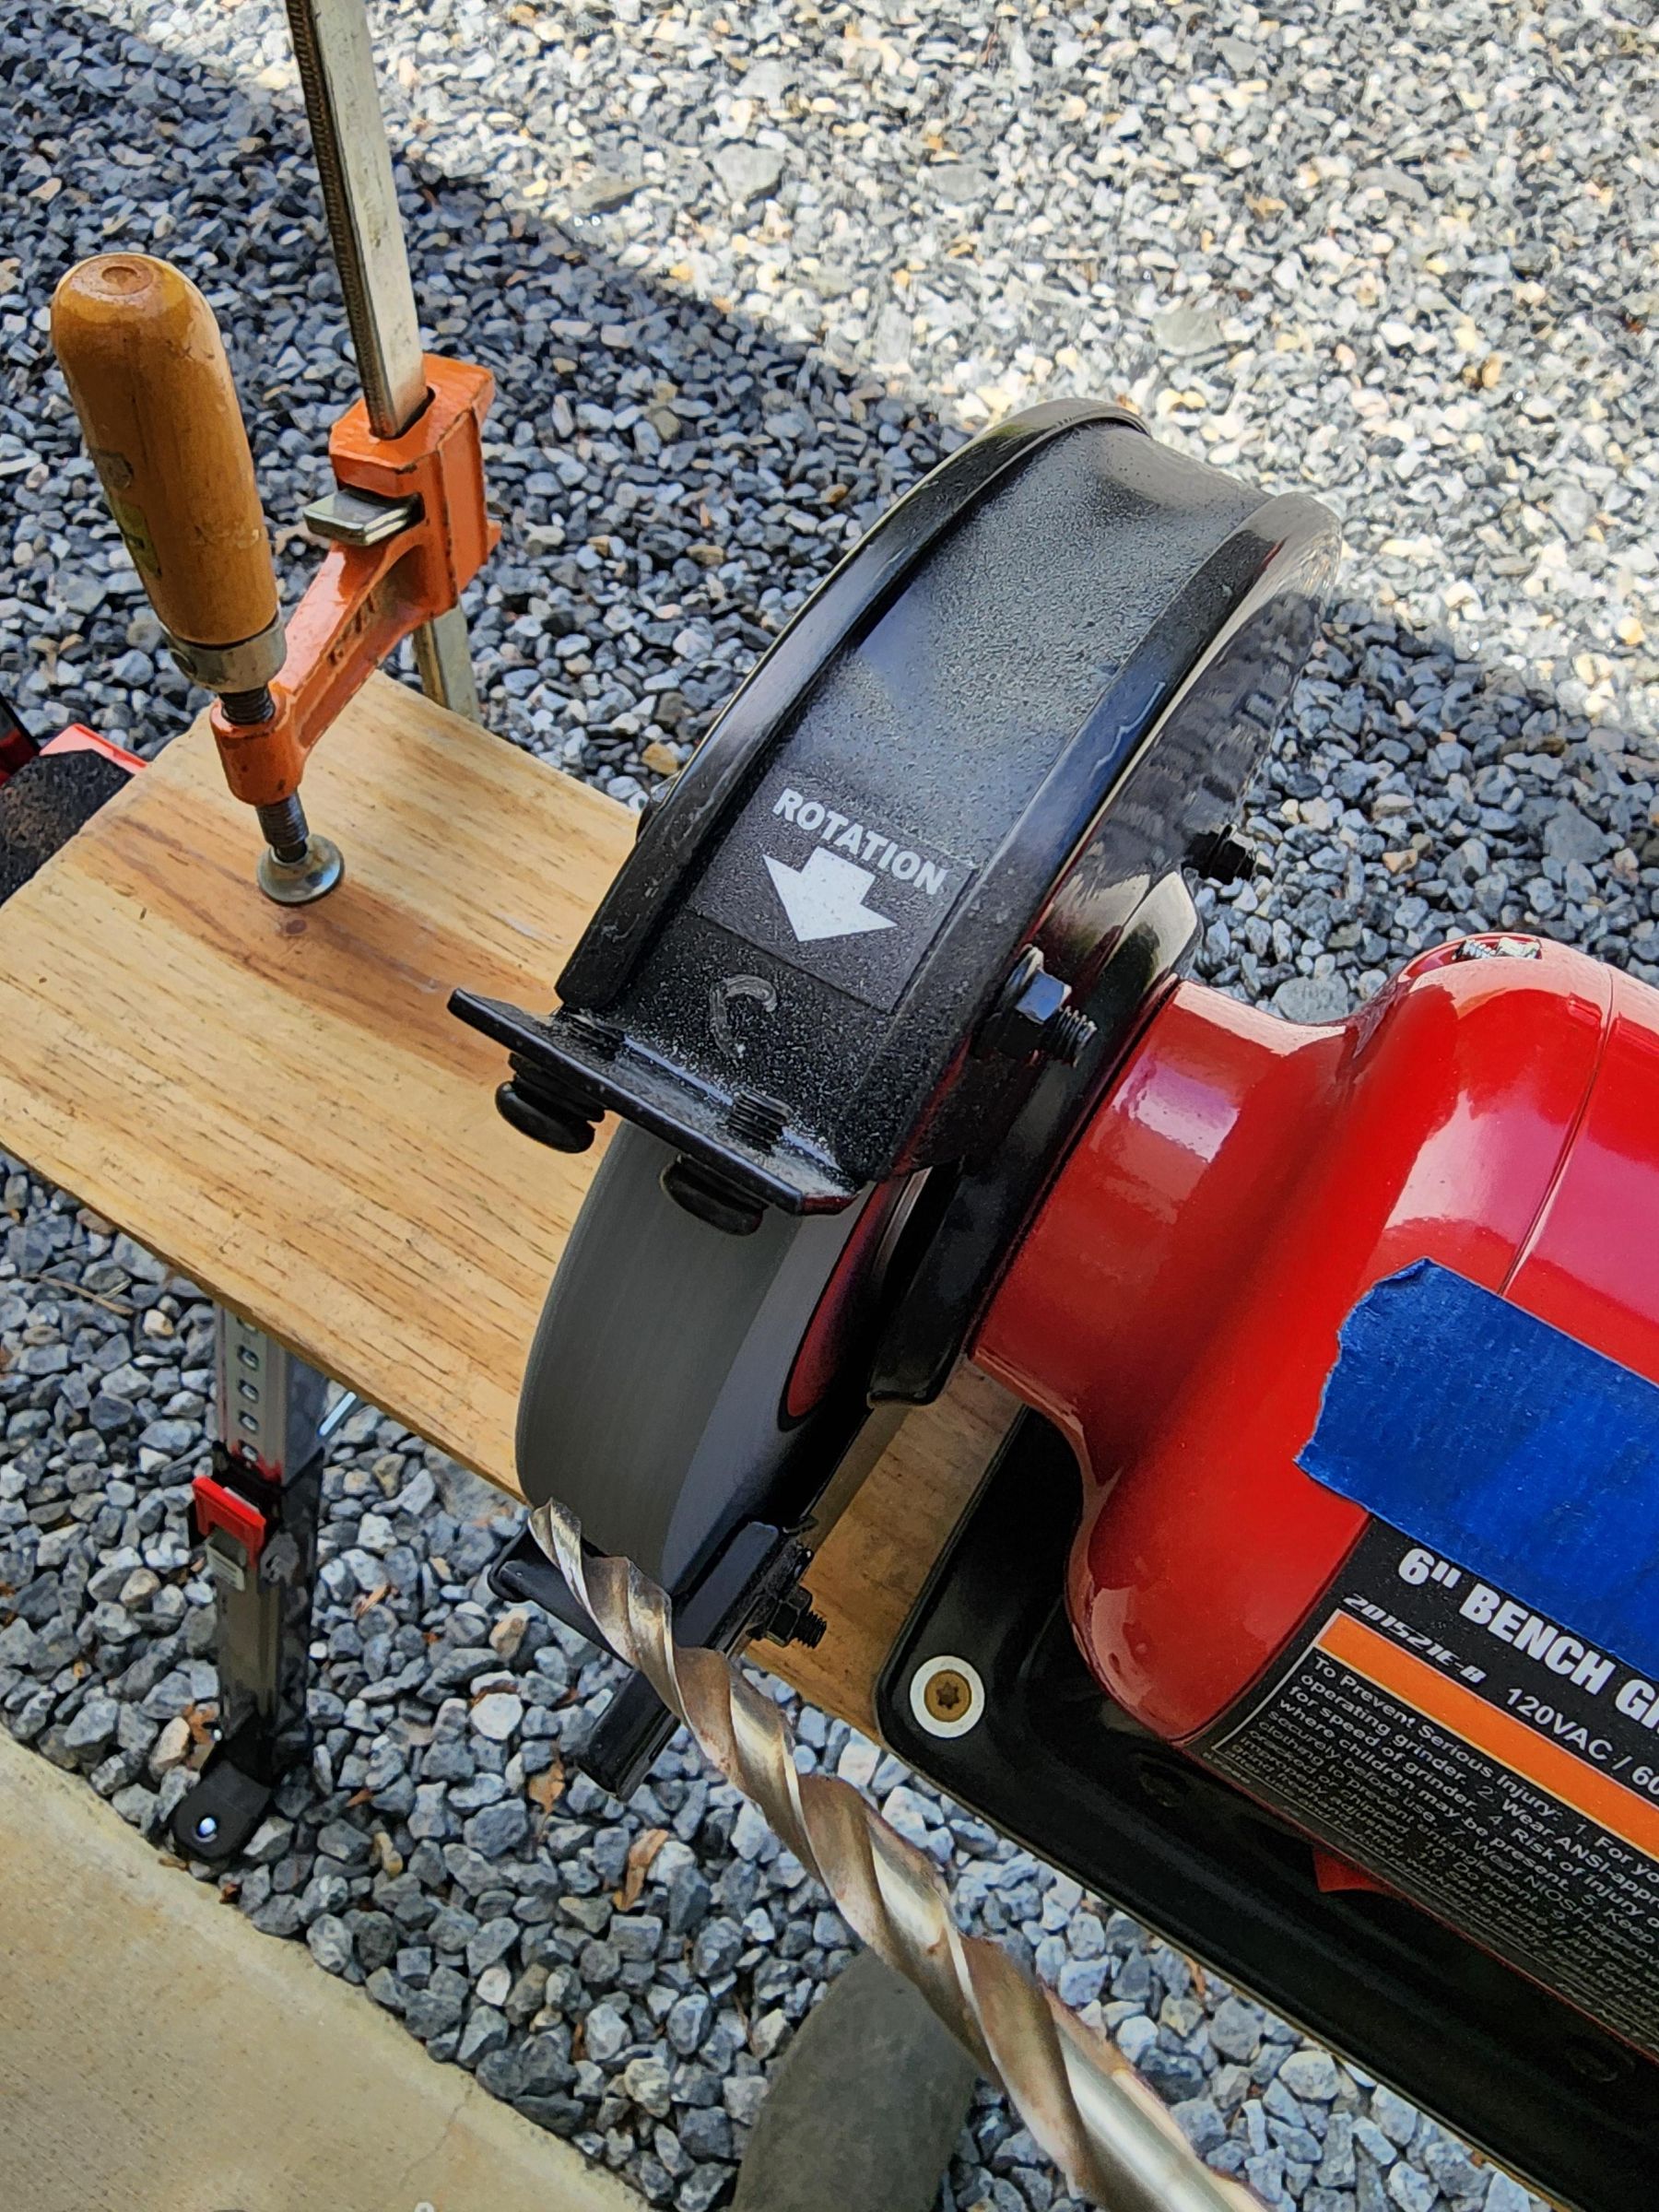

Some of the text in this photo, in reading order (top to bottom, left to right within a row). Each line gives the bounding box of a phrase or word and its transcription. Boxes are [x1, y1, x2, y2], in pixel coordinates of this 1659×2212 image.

[772, 788, 949, 895] ROTATION
[1459, 1583, 1617, 1695] BENCH
[1507, 1688, 1613, 1760] 120VAC
[1612, 1755, 1633, 1771] /
[1248, 1730, 1317, 1774] cracked
[1318, 1775, 1339, 1787] or
[1452, 1861, 1479, 1881] Do
[1482, 1881, 1514, 1903] not
[1514, 1902, 1548, 1925] use
[1258, 1721, 1324, 1767] clothing
[1327, 1764, 1346, 1779] to
[1347, 1776, 1415, 1823] prevent
[1573, 1924, 1642, 1971] Inspect
[1267, 1711, 1342, 1759] securely
[1343, 1757, 1399, 1798] before
[1402, 1796, 1438, 1827] use.
[1474, 1840, 1523, 1875] Wear
[1524, 1875, 1659, 1969] NIOSH-approv
[1279, 1699, 1335, 1738] where
[1338, 1738, 1416, 1790] children
[1418, 1790, 1461, 1818] may
[1461, 1817, 1488, 1837] be
[1490, 1837, 1570, 1892] present.
[1602, 1908, 1655, 1944] Keep
[1288, 1686, 1319, 1707] for
[1319, 1707, 1379, 1747] speed
[1381, 1747, 1406, 1761] of
[1405, 1761, 1477, 1812] grinder.
[1511, 1828, 1557, 1861] Risk
[1559, 1861, 1585, 1877] of
[1300, 1675, 1391, 1736] operating
[1394, 1734, 1466, 1785] grinder.
[1501, 1798, 1556, 1836] Wear
[1553, 1836, 1659, 1909] ANSI-appr
[1314, 1655, 1336, 1678] To
[1339, 1674, 1417, 1729] Prevent
[1418, 1724, 1494, 1778] Serious
[1496, 1774, 1563, 1821] Injury:
[1594, 1836, 1634, 1864] For
